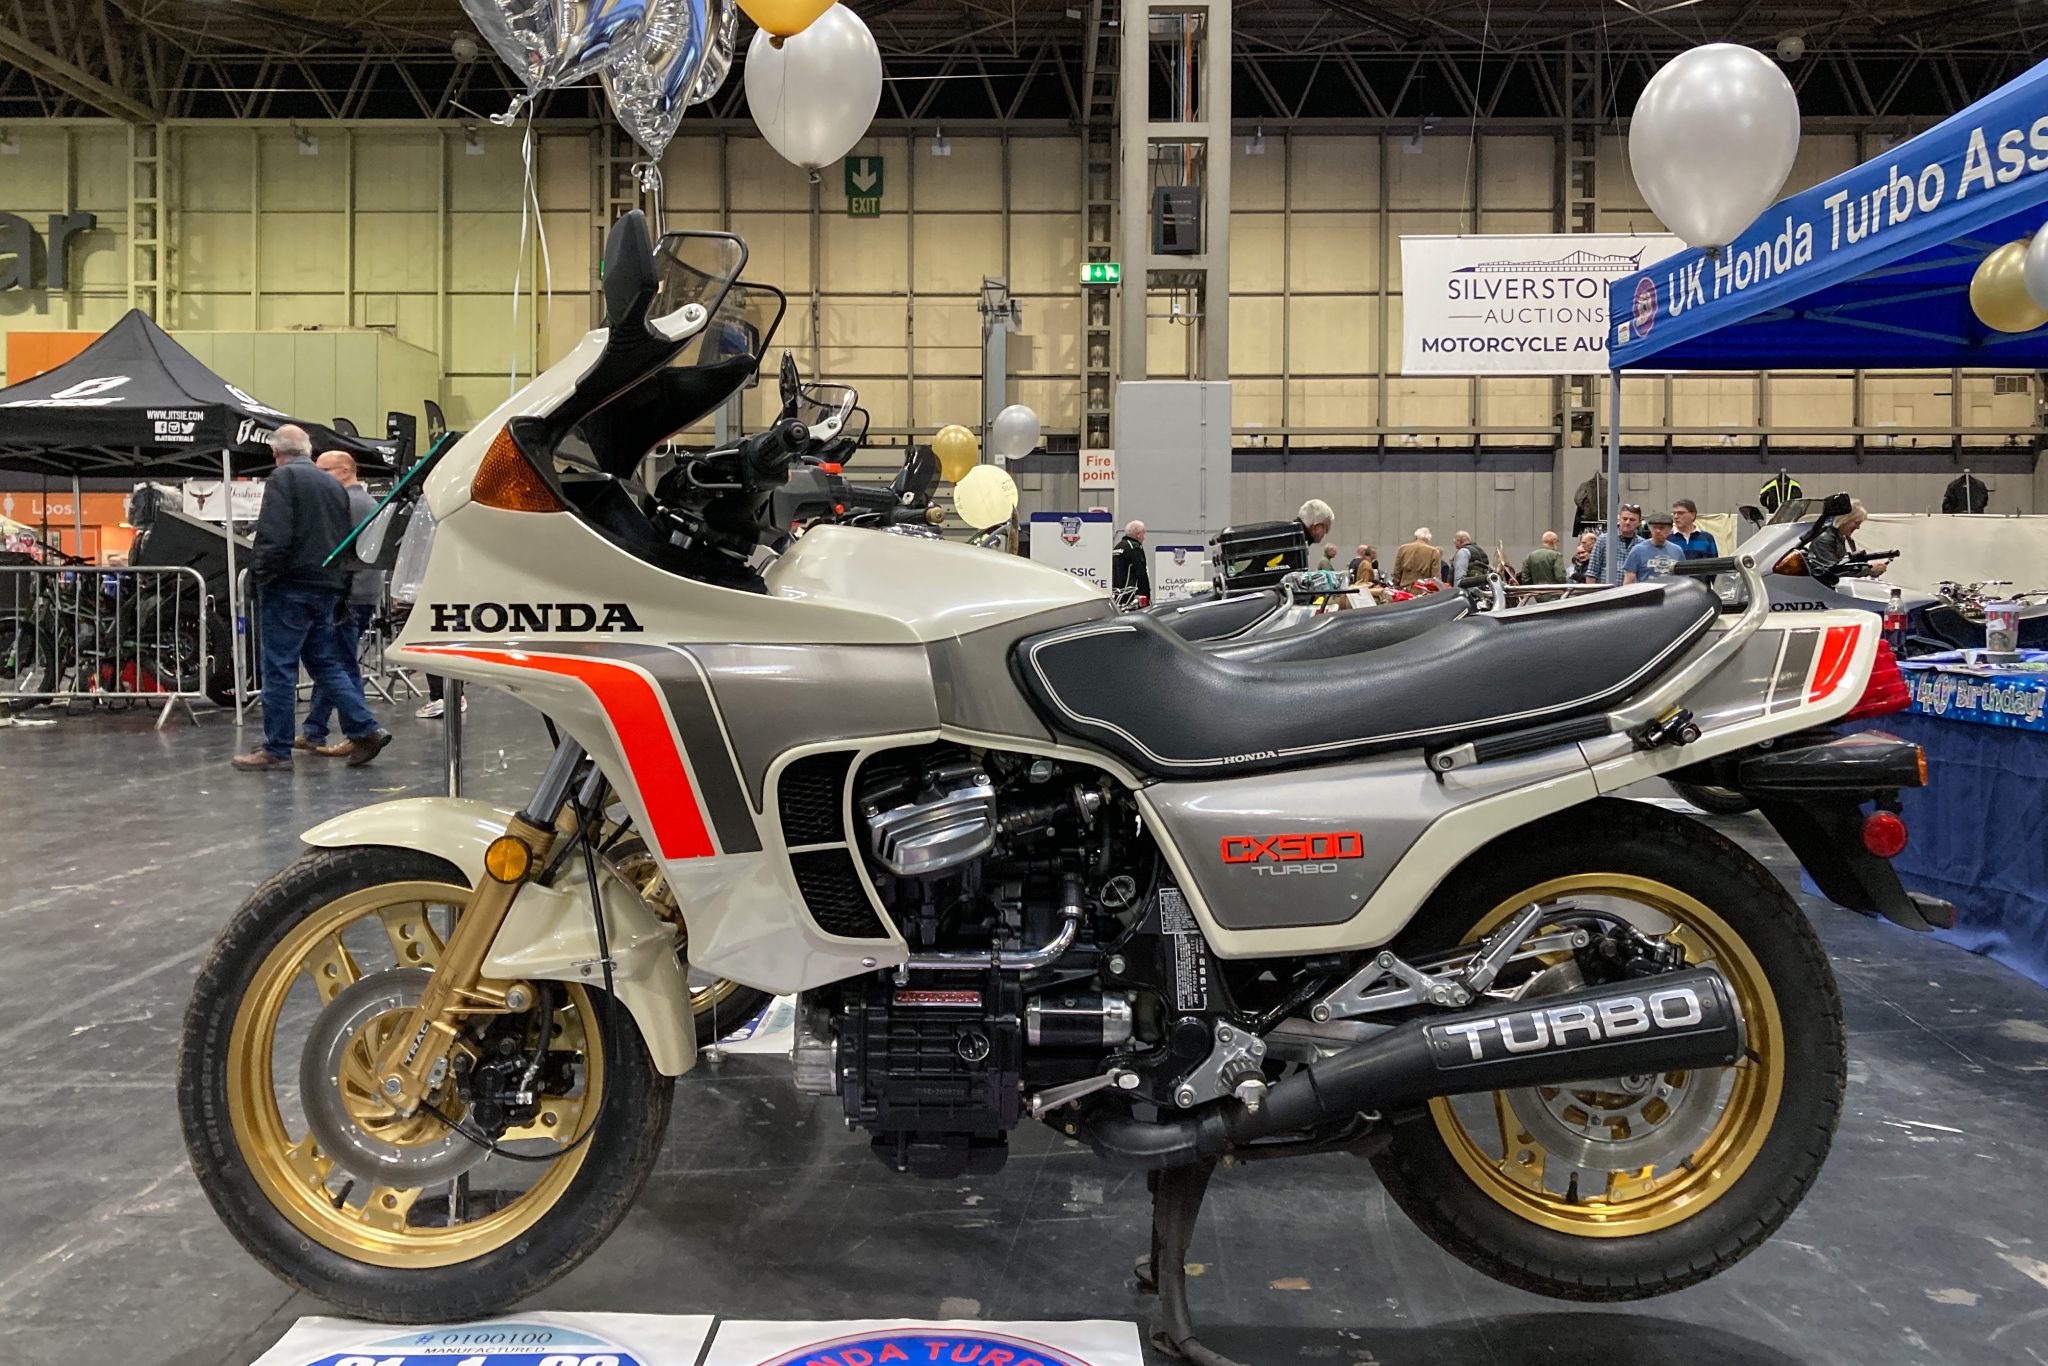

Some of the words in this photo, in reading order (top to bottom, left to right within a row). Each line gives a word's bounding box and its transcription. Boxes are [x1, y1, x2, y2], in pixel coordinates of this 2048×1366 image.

[852, 197, 878, 213] EXIT
[1668, 257, 1706, 317] UK
[1713, 215, 1813, 300] Honda
[1824, 163, 1945, 251] Turbo
[1484, 307, 1604, 324] AUCTIONS
[1422, 336, 1567, 353] MOTORCYCLE
[146, 410, 204, 421] WWW.JITSIE.COM
[1086, 455, 1111, 467] Fire
[1082, 470, 1115, 482] point
[1263, 564, 1291, 572] HONDA
[1769, 601, 1829, 613] ONDA
[431, 602, 643, 633] HONDA
[1955, 679, 2046, 723] Birthday!
[1223, 750, 1278, 765] HONDA
[1220, 831, 1364, 863] CX500
[1251, 863, 1338, 876] TURBO
[1445, 988, 1702, 1060] TURBO
[404, 1019, 431, 1063] TRAC
[443, 1333, 553, 1345] 0100100
[424, 1346, 545, 1354] MANUFACTURED
